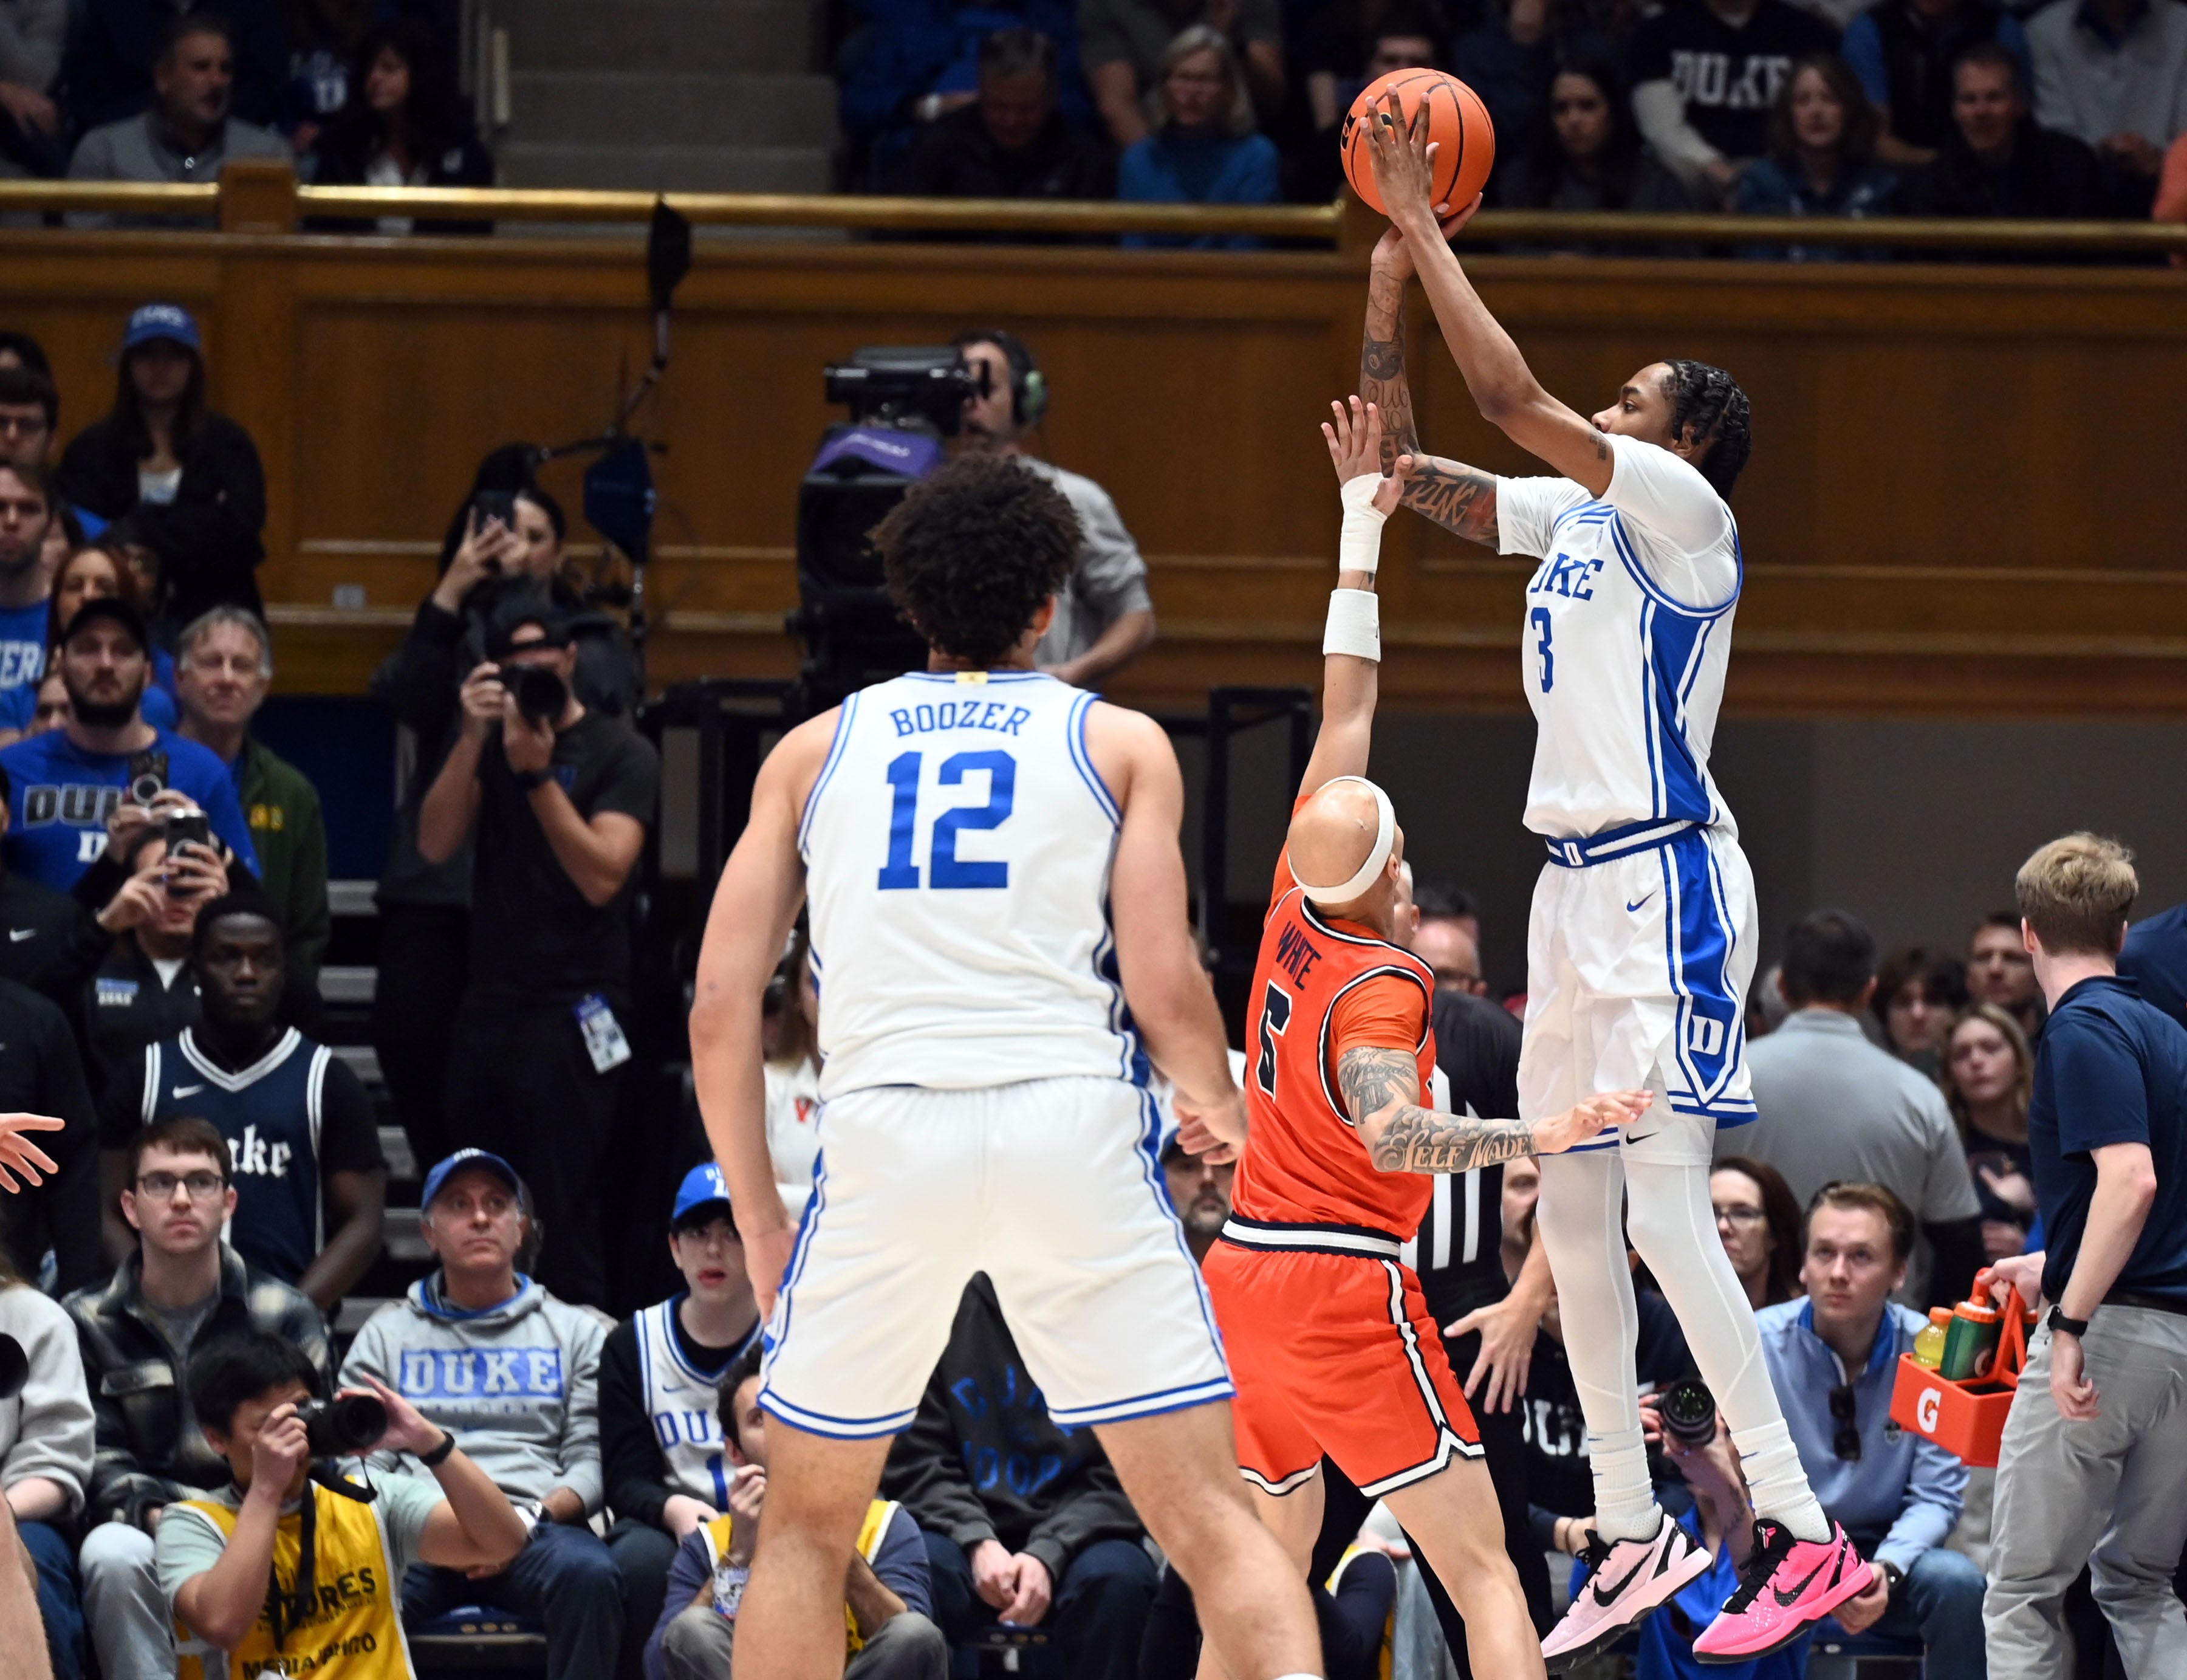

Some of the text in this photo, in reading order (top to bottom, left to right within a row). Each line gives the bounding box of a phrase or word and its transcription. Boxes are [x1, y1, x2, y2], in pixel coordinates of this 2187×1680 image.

[1530, 607, 1554, 693] 3
[890, 701, 1031, 737] BOOZER
[878, 750, 1018, 890] 12
[1688, 1013, 1725, 1056] D
[402, 1351, 558, 1394] DUKE
[654, 1408, 725, 1449] DU
[1917, 1387, 1942, 1433] G
